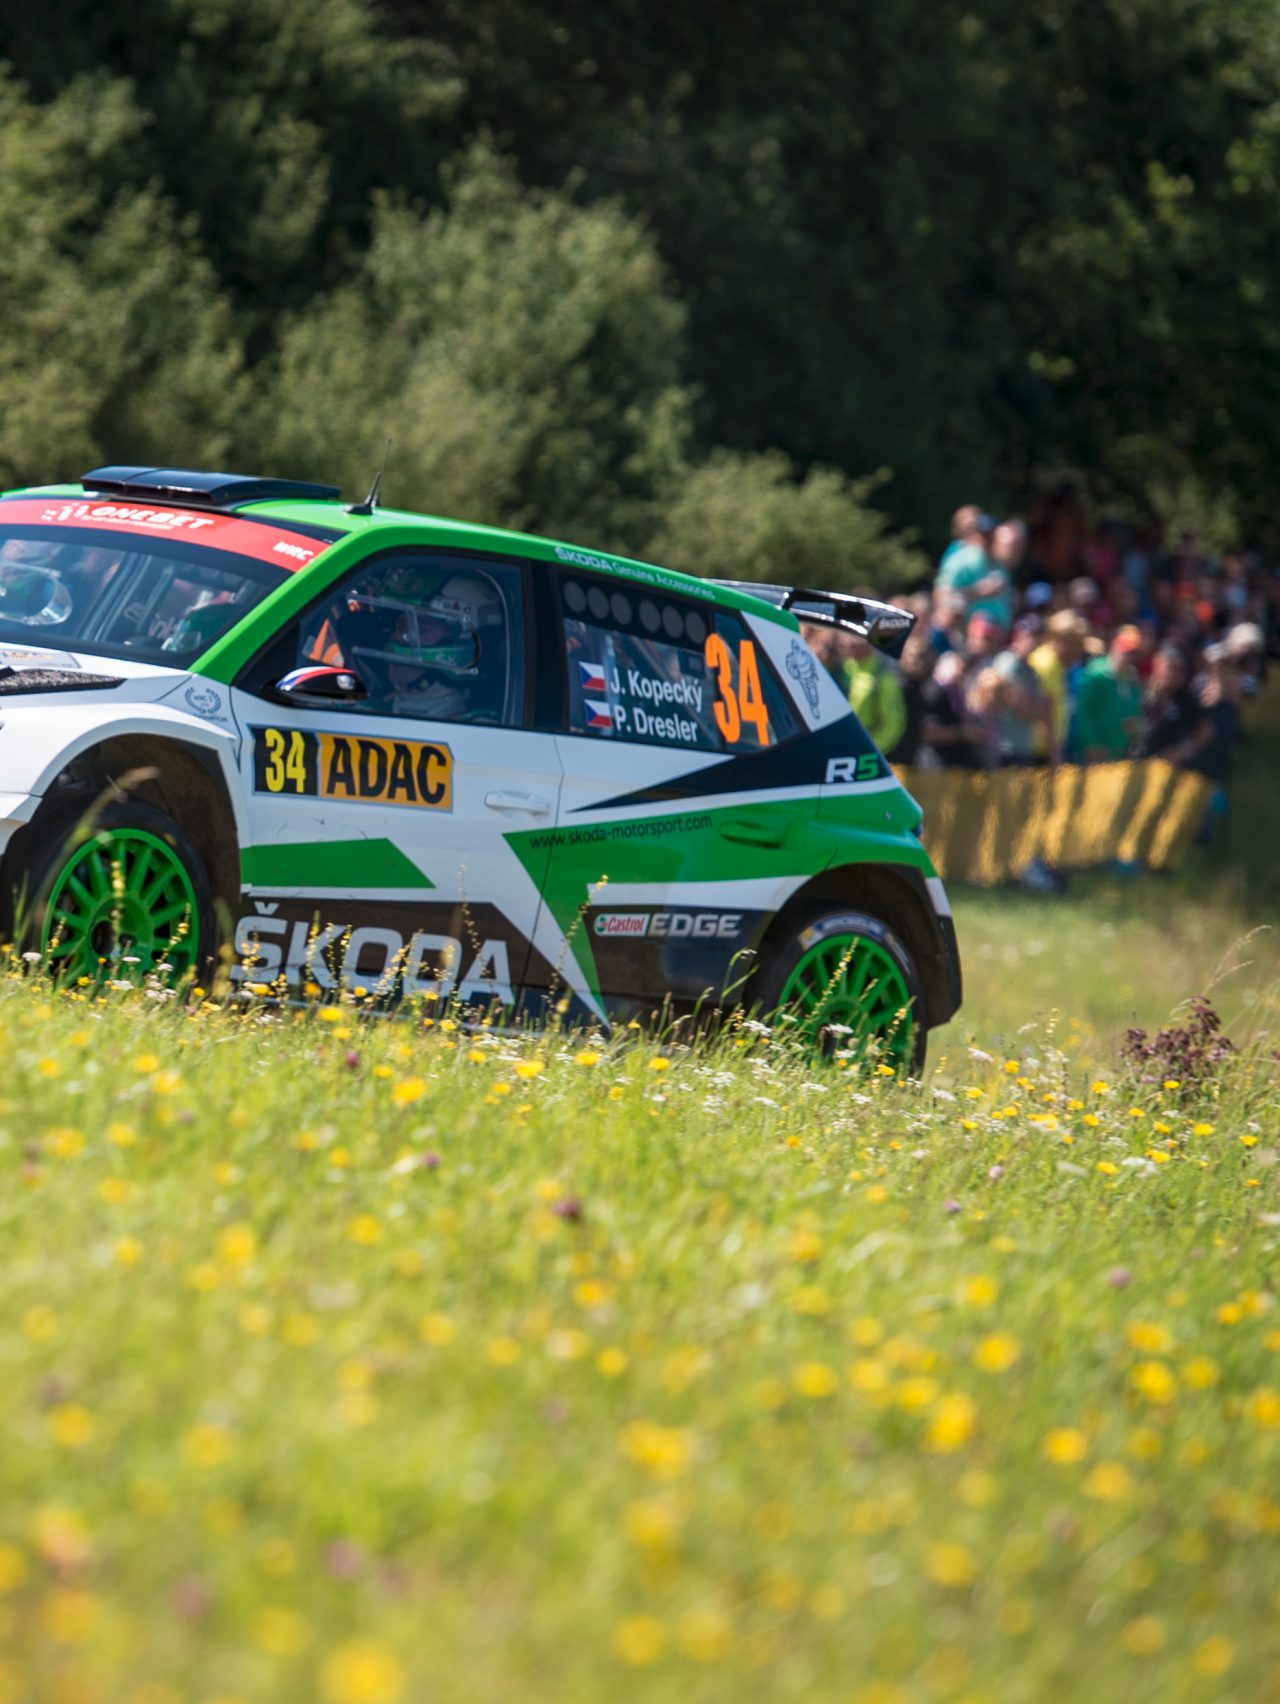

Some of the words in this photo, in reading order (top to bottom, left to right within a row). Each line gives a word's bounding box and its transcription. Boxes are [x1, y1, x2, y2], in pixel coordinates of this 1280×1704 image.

[555, 546, 613, 571] ŠKODA
[610, 667, 626, 695] J.
[627, 669, 703, 713] Kopecký
[704, 633, 770, 747] 34
[614, 704, 631, 733] P.
[633, 707, 698, 742] Dresler
[265, 728, 307, 794] 34
[326, 737, 448, 805] ADAC
[825, 754, 880, 783] R5
[530, 815, 713, 849] www.skoda-motorsport.com
[608, 916, 646, 933] Castrol
[647, 913, 743, 937] EDGE
[229, 901, 516, 1005] ŠKODA
